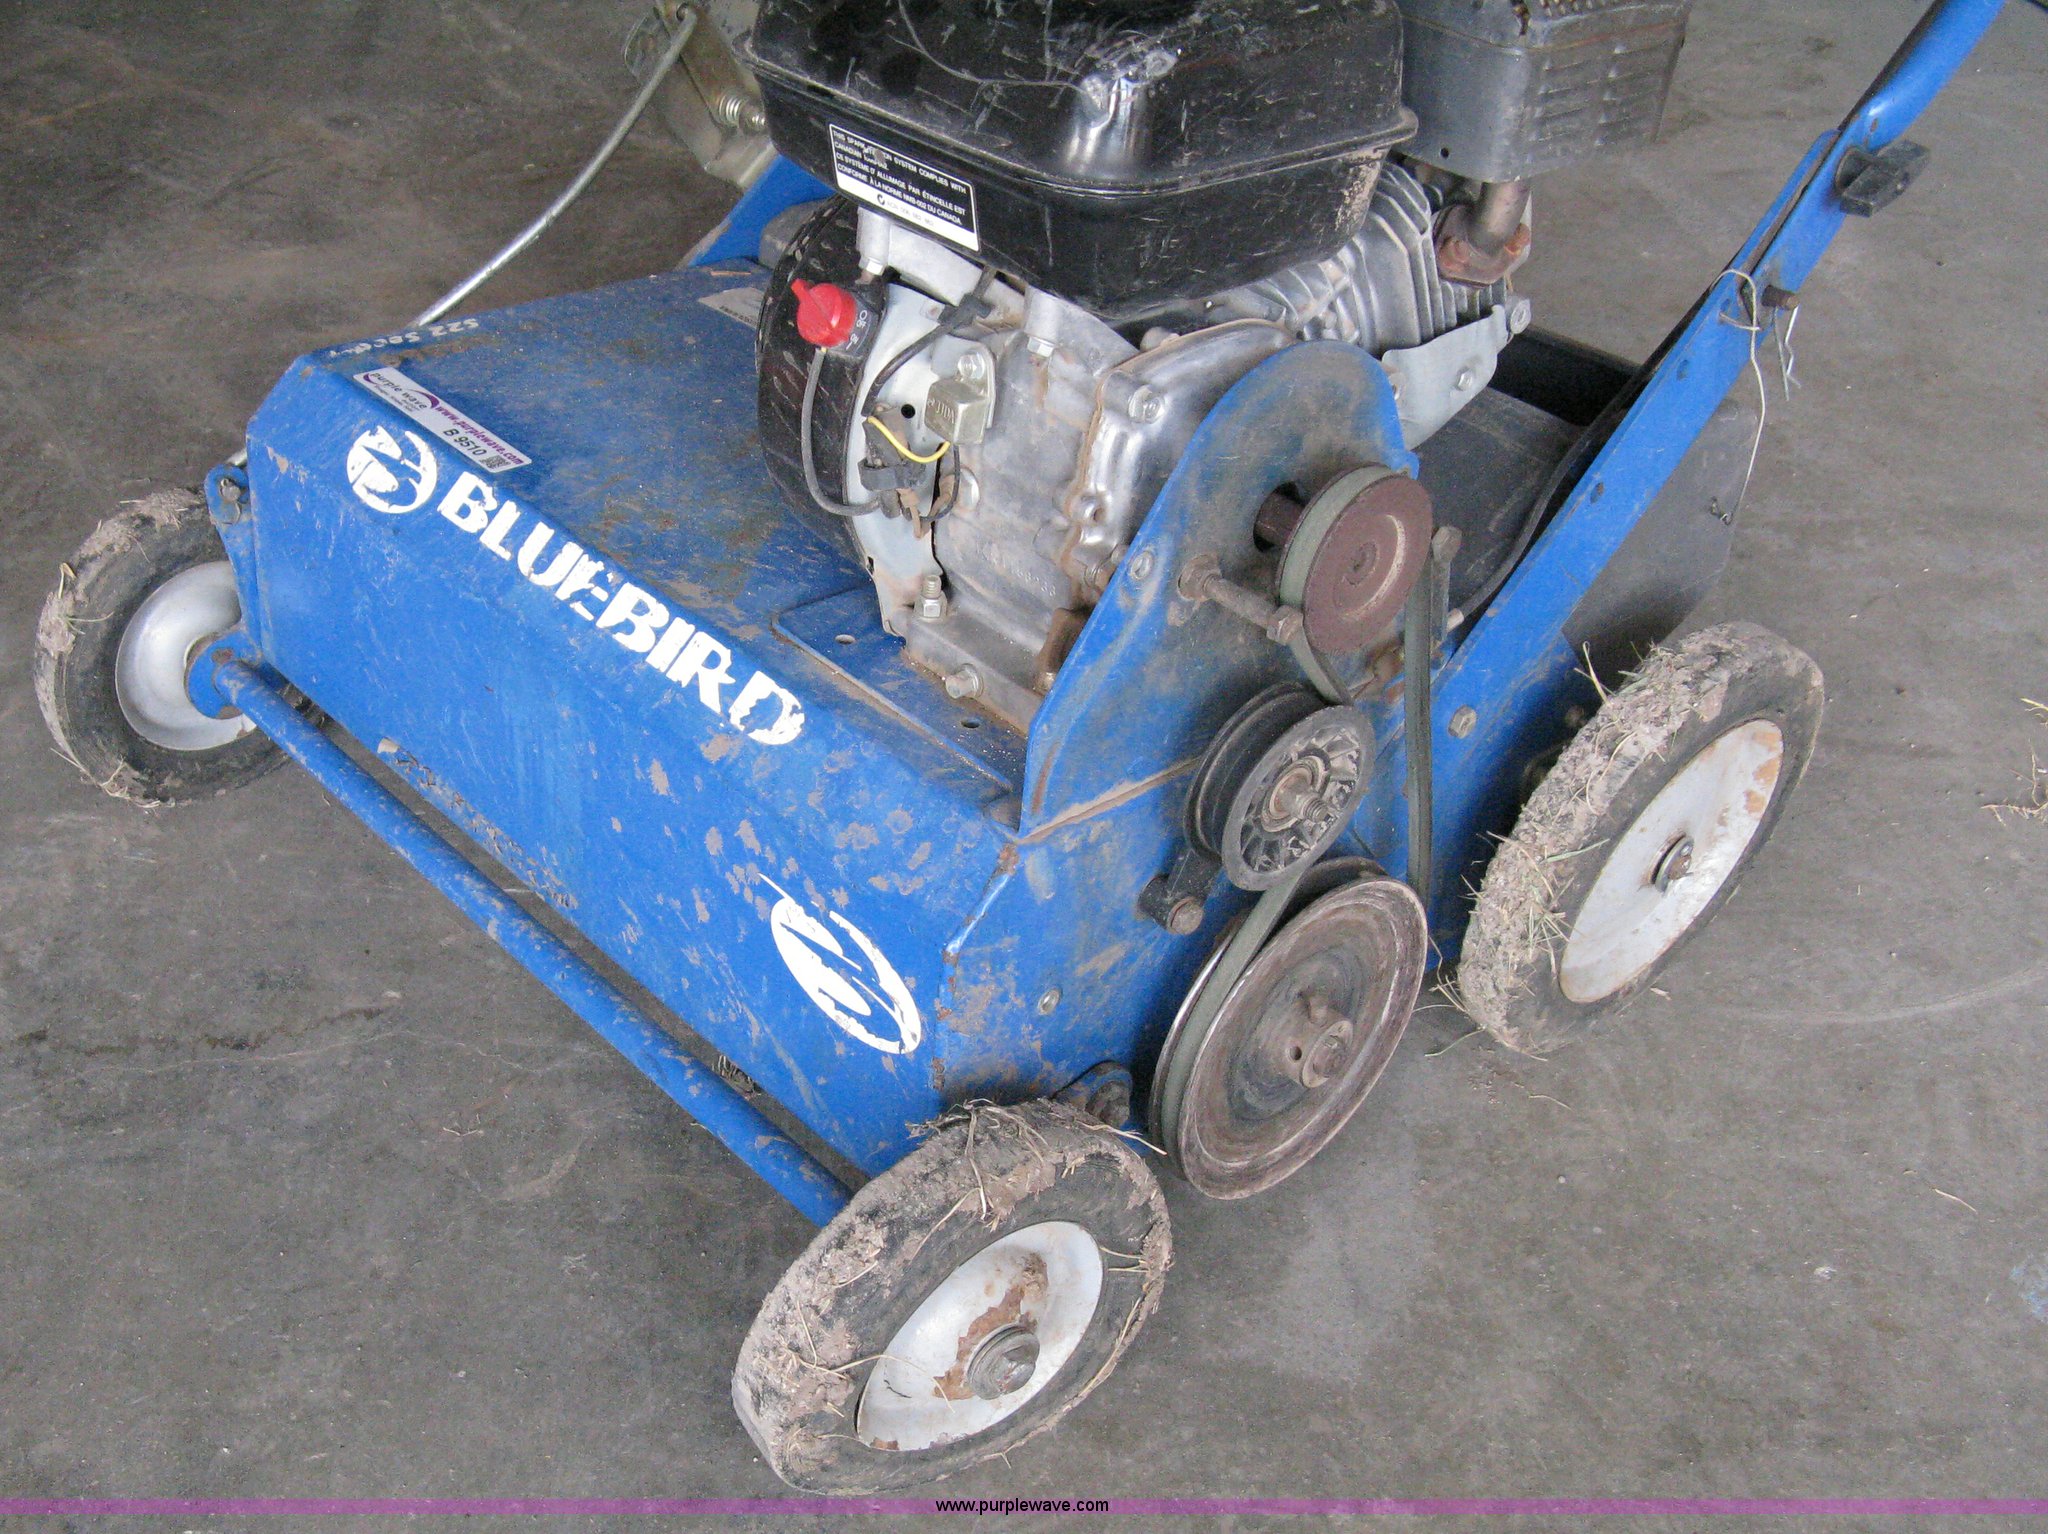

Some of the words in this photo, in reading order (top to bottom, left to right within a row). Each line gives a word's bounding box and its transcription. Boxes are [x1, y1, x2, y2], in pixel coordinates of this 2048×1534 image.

[834, 141, 862, 157] CANADIAN
[836, 151, 844, 161] CE
[876, 170, 906, 189] ALLUMAGE
[907, 185, 921, 195] PAR
[922, 188, 953, 210] ÉTINCELLE
[953, 204, 966, 215] EST
[837, 163, 868, 181] CONFORME
[882, 183, 902, 198] NORME
[893, 157, 917, 172] SYSTEM
[918, 168, 948, 184] COMPLIES
[950, 181, 966, 193] WITH
[856, 319, 867, 329] OFF
[369, 372, 403, 391] purple
[401, 391, 428, 408] wave
[435, 405, 525, 464] www.purplewave.com
[443, 428, 460, 436] B
[453, 435, 487, 456] 9510
